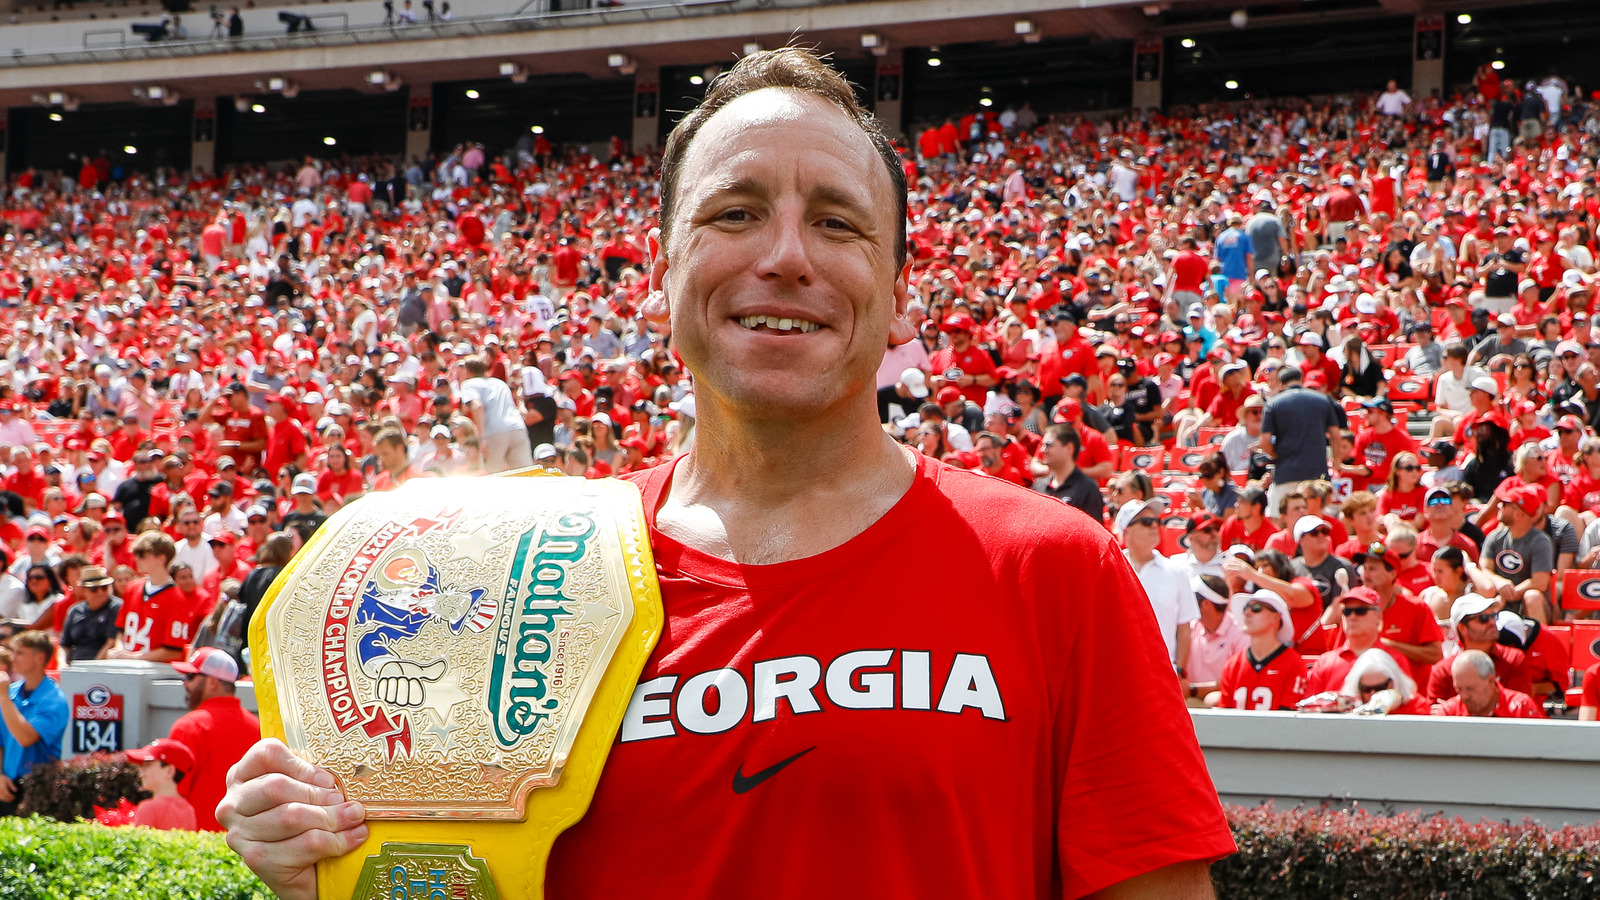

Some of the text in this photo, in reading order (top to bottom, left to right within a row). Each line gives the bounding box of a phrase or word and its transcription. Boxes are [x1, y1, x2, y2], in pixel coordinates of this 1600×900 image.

[124, 611, 154, 653] 84
[324, 521, 402, 727] 2023 WORLD CHAMPION
[496, 579, 520, 657] FAMOUS
[506, 511, 596, 735] Nathan's
[553, 631, 570, 686] Since 1916
[77, 707, 119, 719] SECTION
[88, 688, 111, 704] G
[620, 649, 1007, 744] EORGIA
[76, 721, 117, 752] 134
[452, 884, 467, 900] IN
